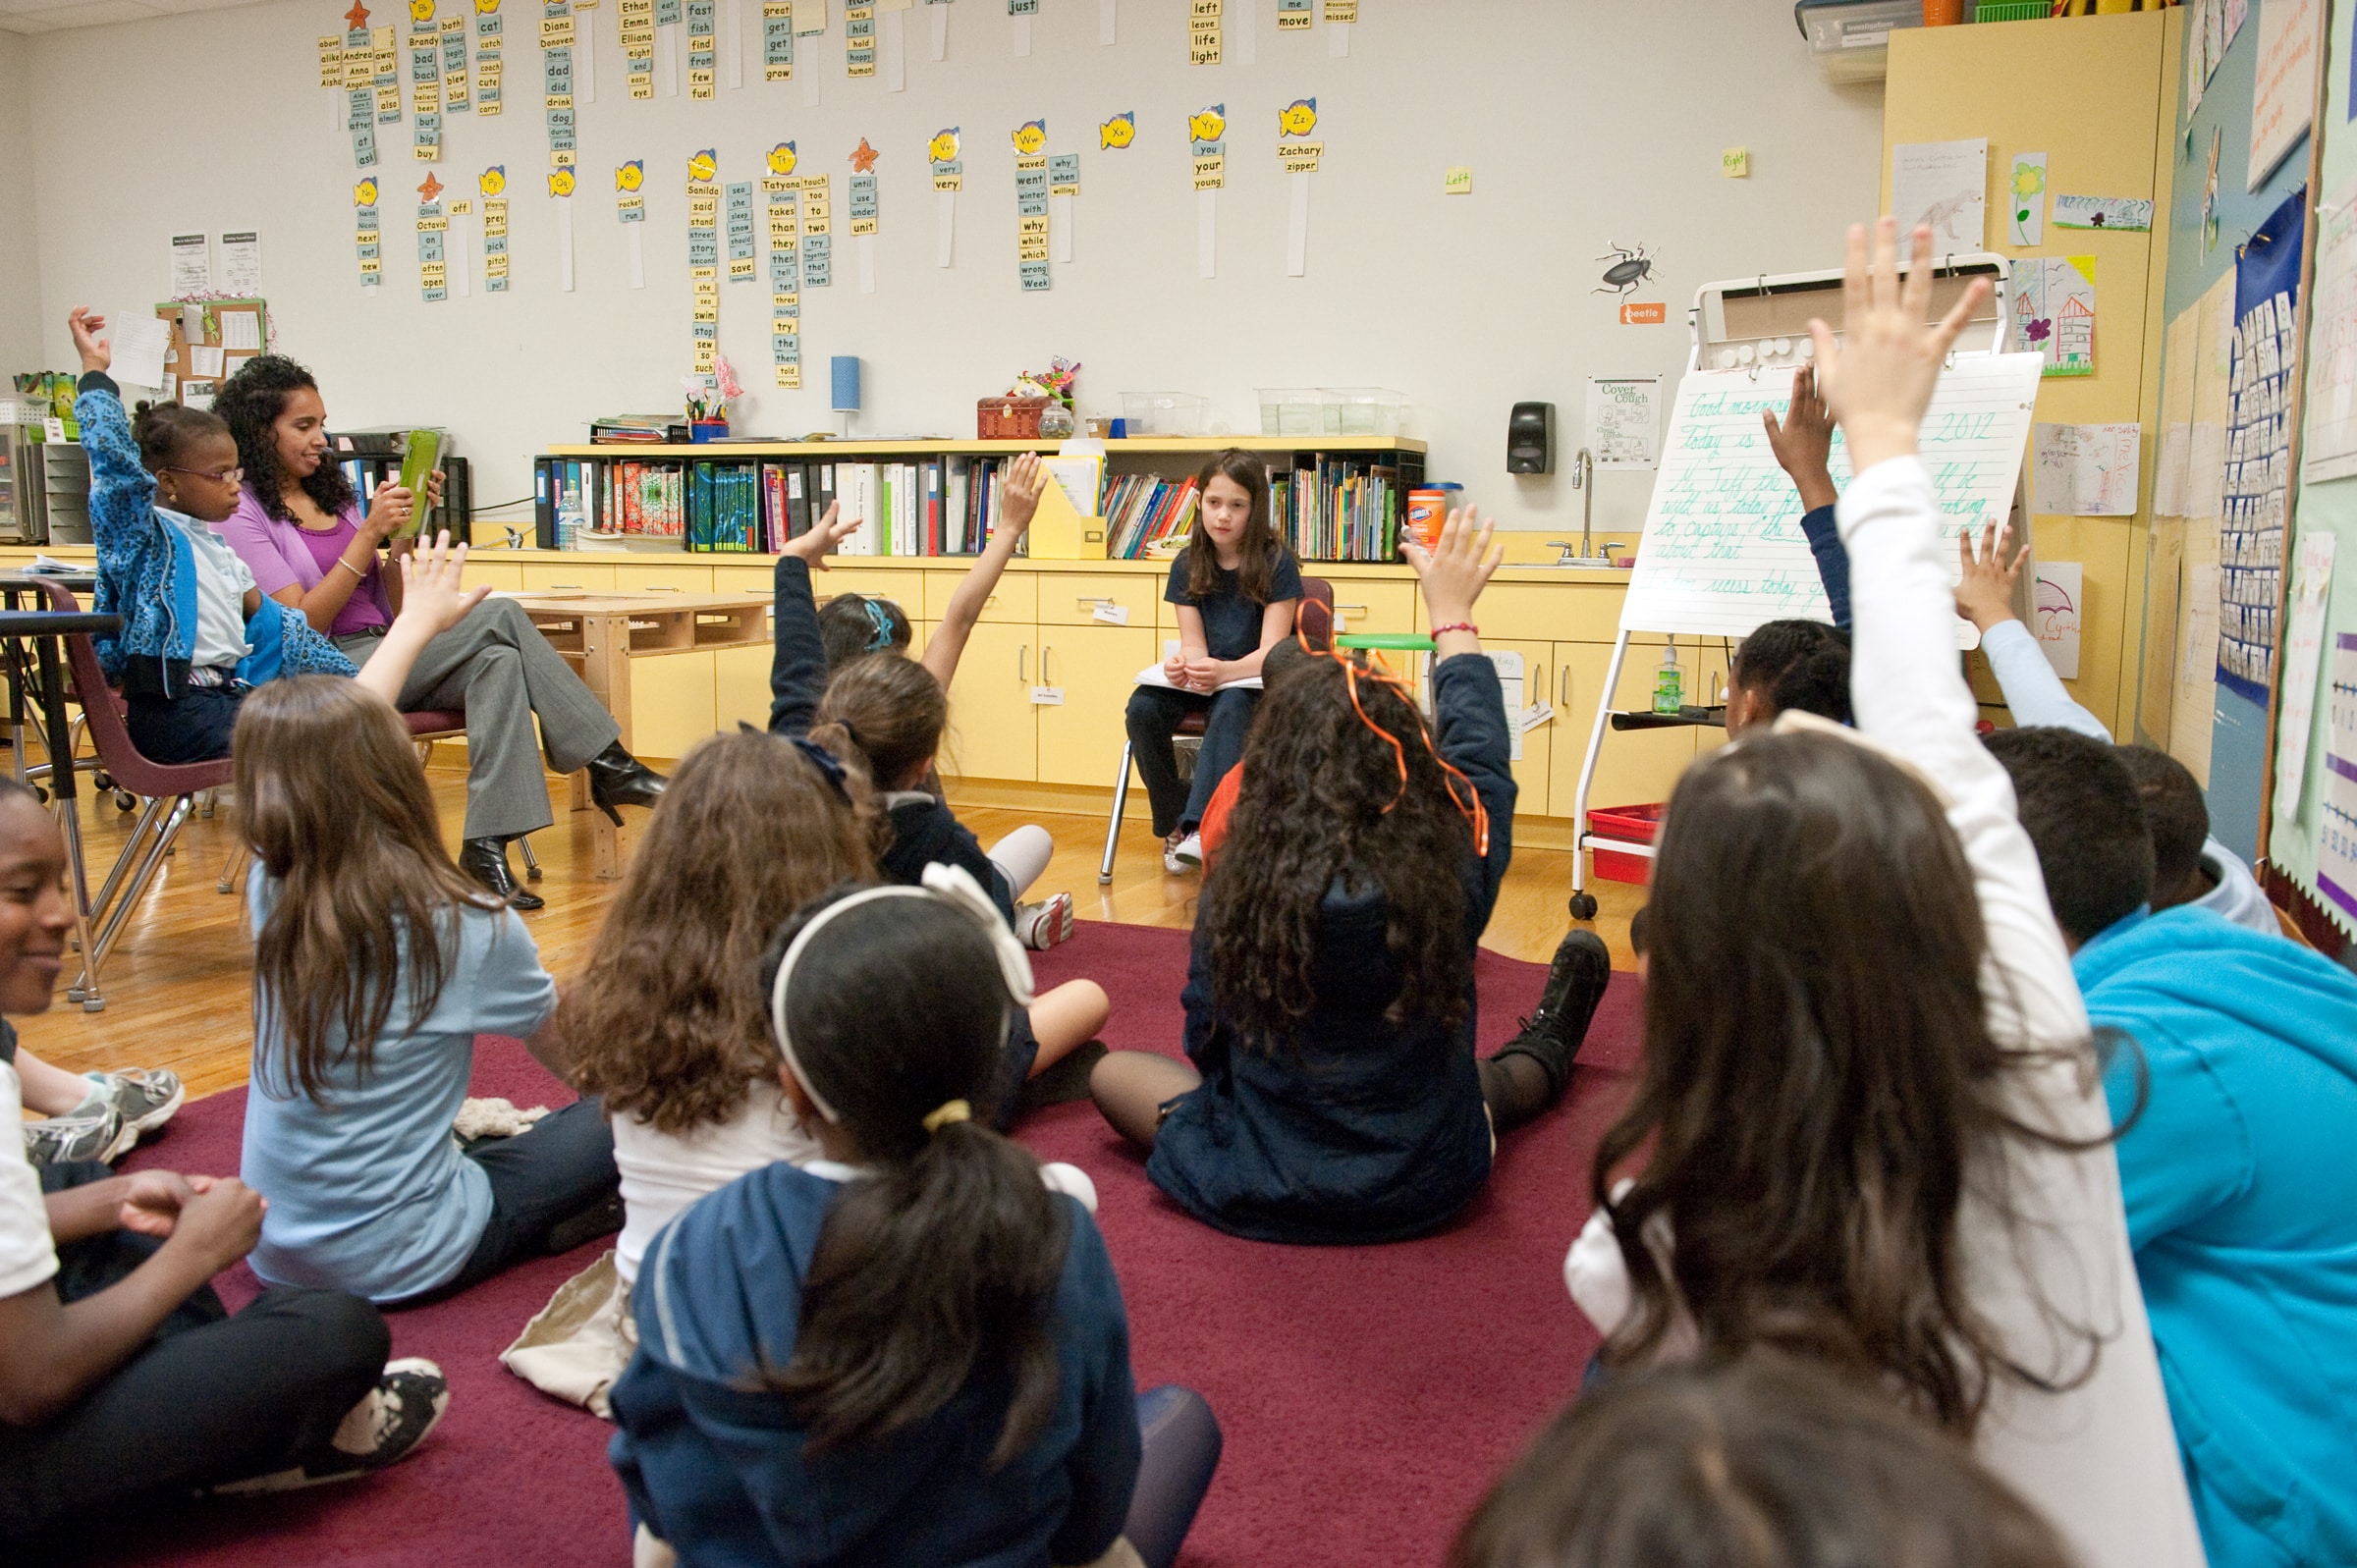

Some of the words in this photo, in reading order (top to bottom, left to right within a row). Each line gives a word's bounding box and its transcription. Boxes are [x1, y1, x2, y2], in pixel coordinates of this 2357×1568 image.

[622, 2, 649, 12] Ethan
[688, 5, 712, 15] fast
[764, 7, 789, 16] great
[1009, 1, 1036, 15] just
[1195, 3, 1217, 14] left
[1279, 16, 1309, 26] move
[1325, 13, 1354, 21] missed
[442, 20, 460, 30] both
[480, 21, 498, 32] cat
[544, 22, 569, 32] Diana
[623, 18, 649, 29] Emma
[691, 23, 710, 33] fish
[769, 22, 785, 34] get
[853, 23, 868, 34] hid
[1191, 20, 1215, 29] leave
[409, 36, 439, 47] Brandy
[481, 39, 500, 48] catch
[621, 34, 652, 44] Elliana
[853, 39, 869, 48] hold
[1195, 35, 1215, 46] life
[691, 39, 710, 50] find
[770, 39, 787, 51] get
[321, 54, 339, 62] alike
[344, 51, 372, 60] Andrea
[376, 52, 395, 60] away
[415, 53, 433, 63] bad
[629, 49, 650, 59] eight
[1191, 51, 1218, 64] light
[380, 63, 393, 72] ask
[548, 65, 569, 76] dad
[415, 71, 435, 79] back
[692, 72, 709, 82] few
[767, 70, 790, 80] grow
[551, 82, 566, 92] did
[449, 91, 464, 101] blue
[634, 89, 648, 99] eye
[692, 88, 711, 98] fuel
[381, 101, 397, 109] also
[547, 97, 571, 107] drink
[420, 118, 434, 126] but
[552, 113, 569, 124] dog
[358, 137, 367, 147] at
[420, 135, 433, 146] big
[417, 149, 433, 160] buy
[1200, 146, 1217, 155] you
[1279, 146, 1321, 157] Zachary
[359, 152, 373, 164] ask
[558, 154, 568, 163] do
[1723, 151, 1744, 171] Right
[1018, 160, 1045, 168] waved
[1055, 160, 1071, 168] why
[1196, 160, 1221, 174] your
[1287, 162, 1316, 171] zipper
[804, 178, 825, 186] touch
[1018, 175, 1043, 185] went
[1195, 178, 1221, 189] young
[1446, 173, 1469, 185] Left
[688, 186, 719, 195] Sanilda
[763, 180, 800, 191] Tatyana
[935, 180, 959, 191] very
[453, 204, 467, 213] off
[693, 202, 713, 211] said
[810, 207, 821, 215] to
[768, 208, 794, 216] takes
[486, 214, 504, 224] prey
[691, 218, 713, 226] stand
[771, 223, 795, 232] than
[808, 223, 825, 232] two
[854, 223, 873, 232] unit
[1024, 221, 1044, 232] why
[488, 241, 504, 251] pick
[773, 239, 794, 250] they
[1022, 237, 1043, 245] while
[427, 250, 436, 259] of
[691, 245, 715, 254] story
[772, 255, 794, 263] then
[1021, 251, 1045, 260] which
[488, 257, 505, 266] pitch
[731, 264, 751, 273] save
[1021, 266, 1046, 275] wrong
[423, 279, 443, 289] open
[1024, 278, 1048, 287] Week
[694, 311, 714, 319] swim
[777, 323, 792, 332] try
[694, 328, 712, 338] stop
[778, 339, 793, 348] the
[695, 364, 713, 372] such
[1602, 383, 1636, 394] Cover
[1615, 393, 1648, 406] Cough
[1690, 391, 1727, 418] Good
[1932, 412, 1996, 442] 2012
[1734, 434, 1754, 448] is
[1703, 501, 1721, 514] us
[1654, 516, 1675, 536] to
